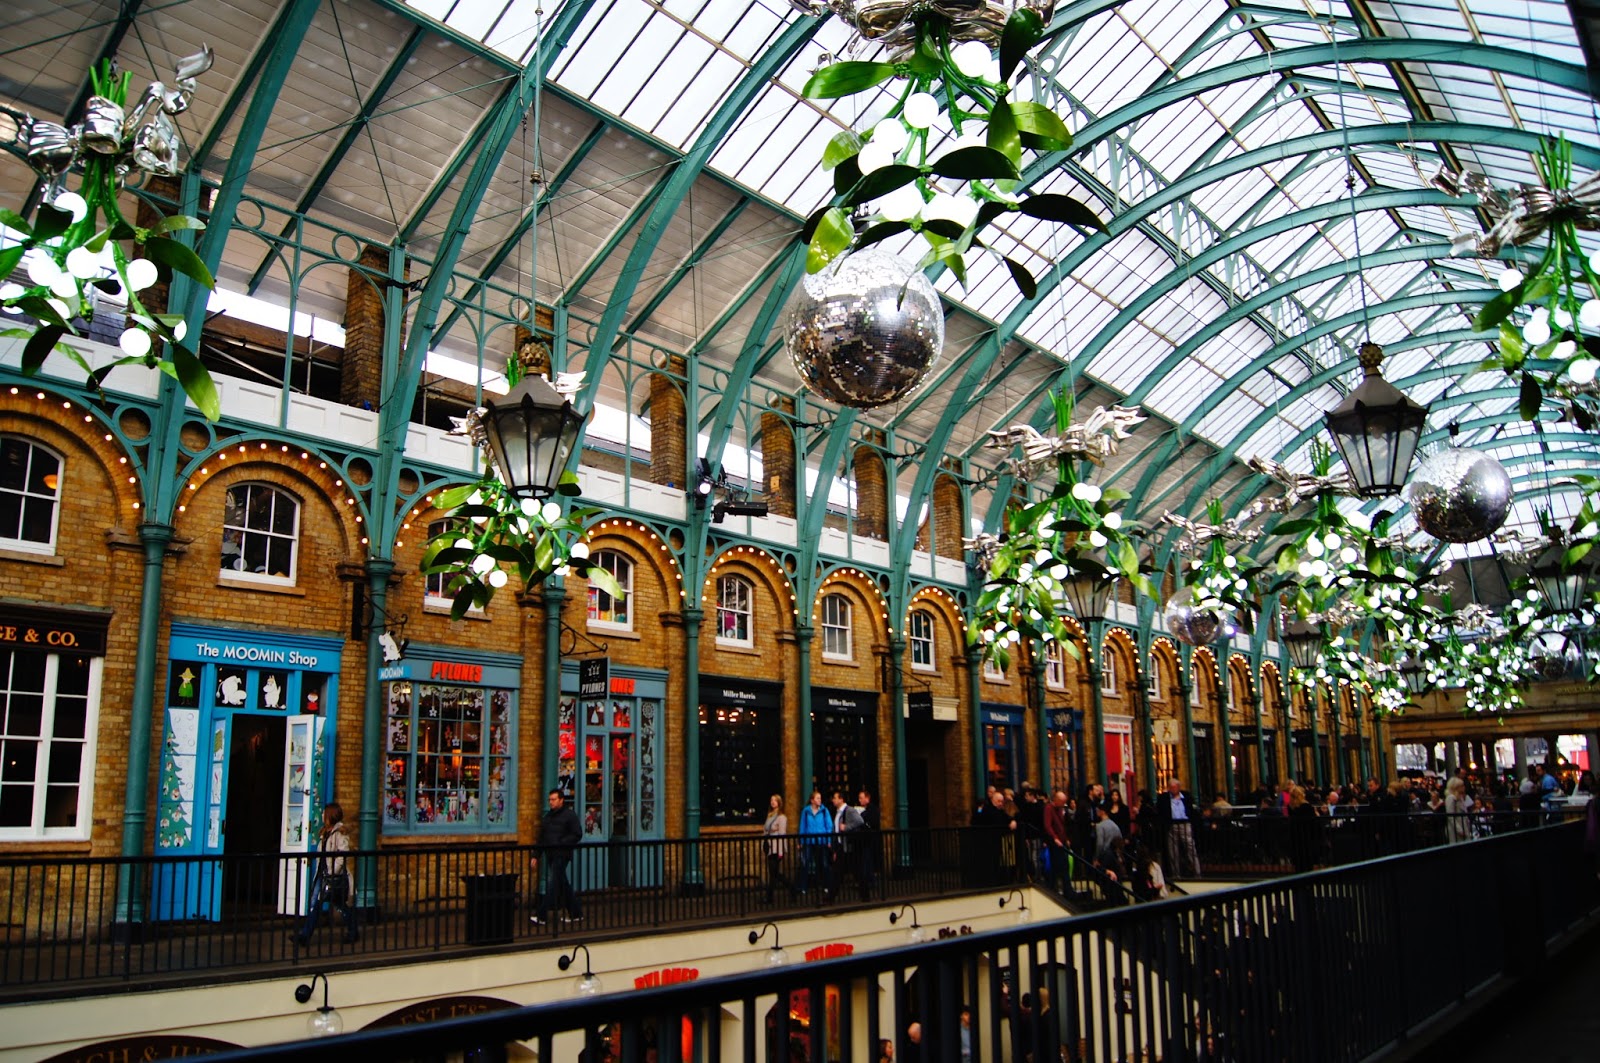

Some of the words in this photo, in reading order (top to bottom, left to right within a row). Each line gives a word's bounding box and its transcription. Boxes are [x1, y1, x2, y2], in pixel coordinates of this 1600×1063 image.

[24, 628, 39, 643] &
[46, 630, 79, 647] CO.
[197, 643, 219, 657] The
[223, 645, 285, 663] MOOMIN
[288, 651, 318, 668] Shop
[380, 667, 404, 679] MOOMIN
[430, 661, 483, 683] PYLONES
[581, 681, 606, 694] PYLONES
